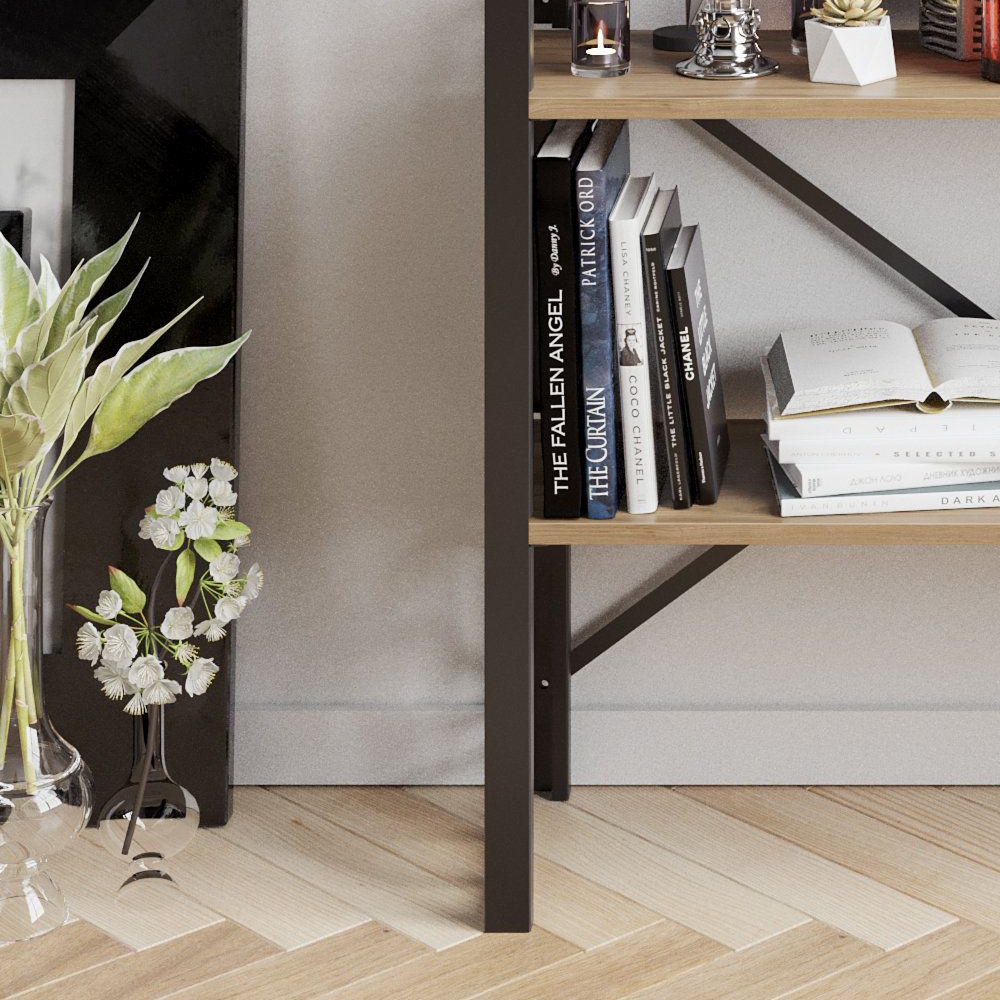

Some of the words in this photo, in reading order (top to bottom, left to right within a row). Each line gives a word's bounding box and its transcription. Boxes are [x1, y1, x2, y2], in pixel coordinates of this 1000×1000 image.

[577, 177, 594, 213] ORD
[549, 233, 560, 262] Danny
[580, 217, 597, 286] PATRICK
[620, 241, 629, 267] LISA
[551, 261, 563, 276] By
[622, 271, 632, 317] CHANEY
[548, 289, 565, 363] ANGEL
[656, 316, 668, 355] JACKET
[679, 325, 696, 382] CHANEL
[660, 357, 671, 390] BLACK
[550, 367, 567, 448] FALLEN
[628, 375, 640, 419] COCO
[665, 392, 675, 425] LITTLE
[585, 386, 608, 463] CURTAIN
[669, 427, 678, 449] THE
[632, 425, 645, 485] CHANEL
[893, 450, 976, 458] SELECTED
[553, 451, 569, 495] THE
[588, 465, 609, 501] THE
[923, 469, 958, 481] ДНЕВНИК
[941, 495, 985, 505] DARK
